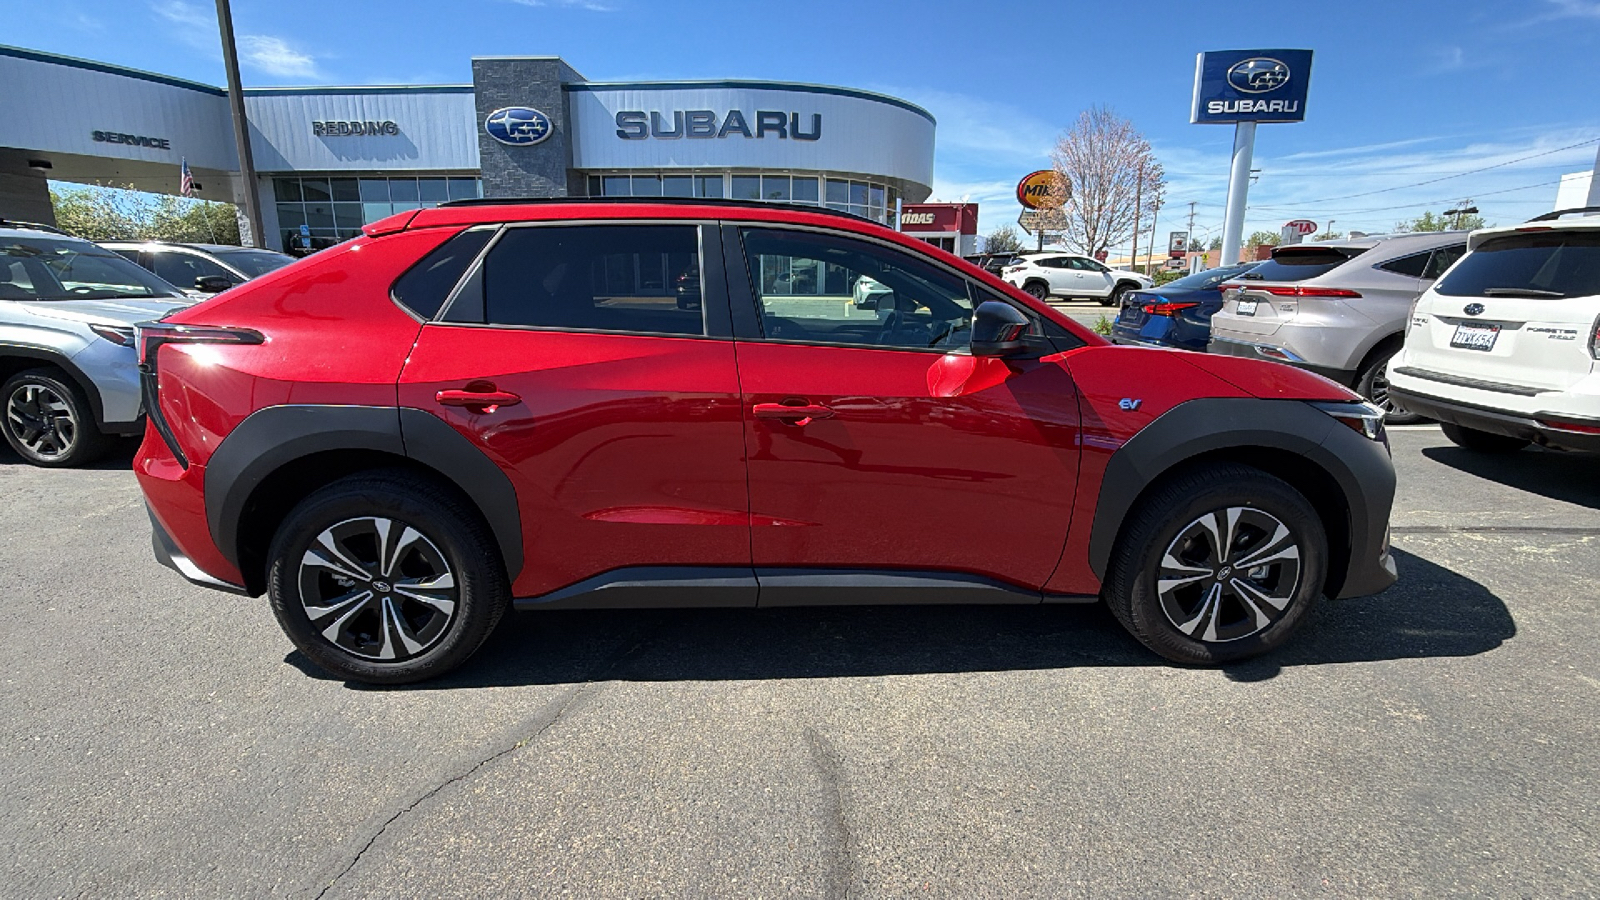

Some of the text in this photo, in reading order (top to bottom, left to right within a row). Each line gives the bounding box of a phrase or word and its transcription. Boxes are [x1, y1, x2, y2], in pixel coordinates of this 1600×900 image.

[1208, 100, 1298, 114] SUBARU
[312, 121, 398, 136] REDDING
[616, 110, 822, 141] SUBARU
[92, 130, 171, 150] SERVICE
[1118, 398, 1142, 410] EV
